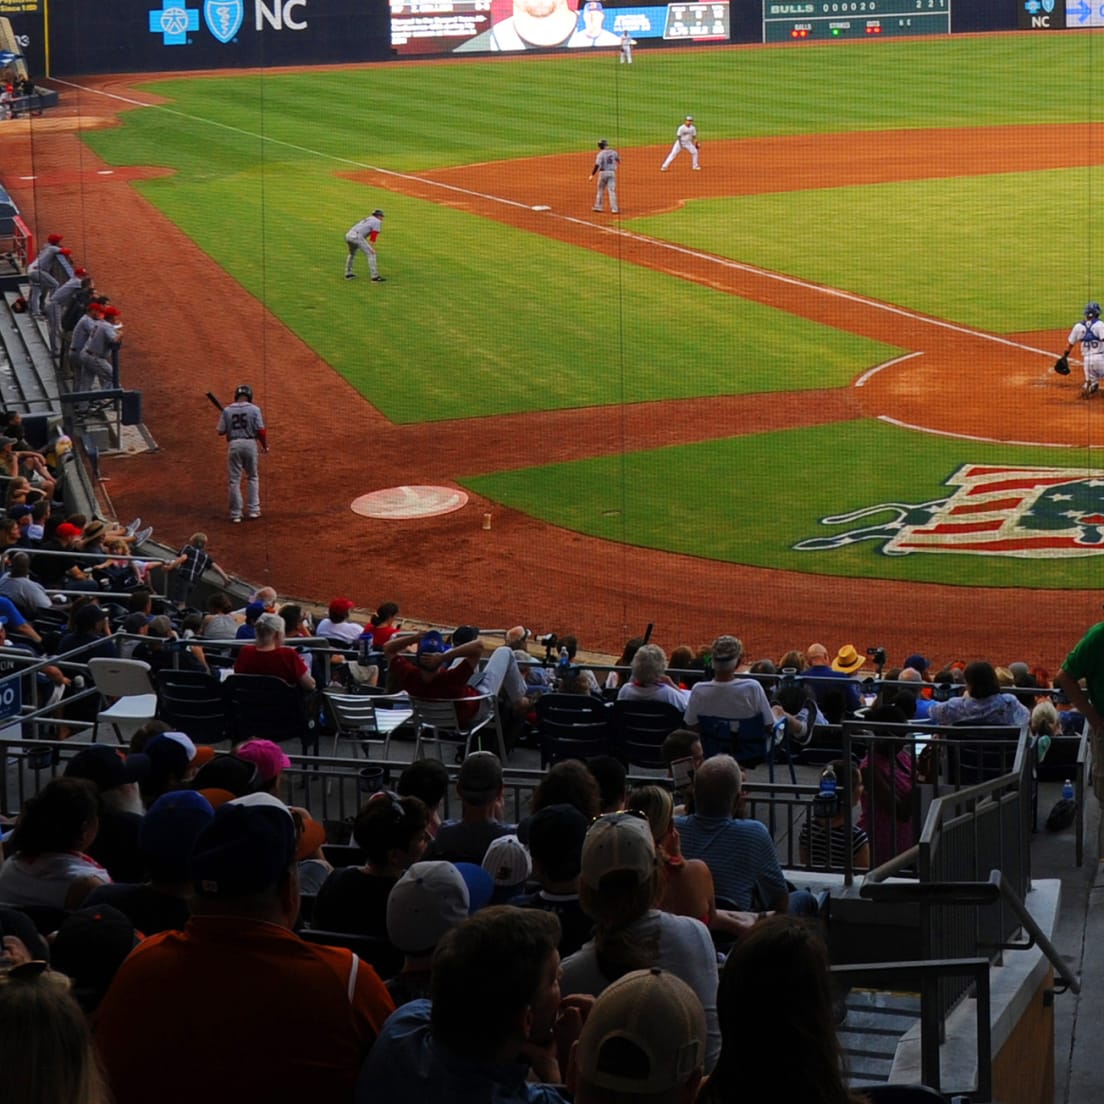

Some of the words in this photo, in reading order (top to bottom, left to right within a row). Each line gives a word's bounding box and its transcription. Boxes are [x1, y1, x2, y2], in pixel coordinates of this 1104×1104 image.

[771, 4, 814, 14] BULLS
[823, 4, 828, 12] 0
[832, 3, 838, 11] 0
[842, 3, 847, 11] 0
[851, 2, 856, 10] 0
[916, 0, 921, 8] 2
[1032, 16, 1050, 27] NC
[232, 414, 247, 430] 26
